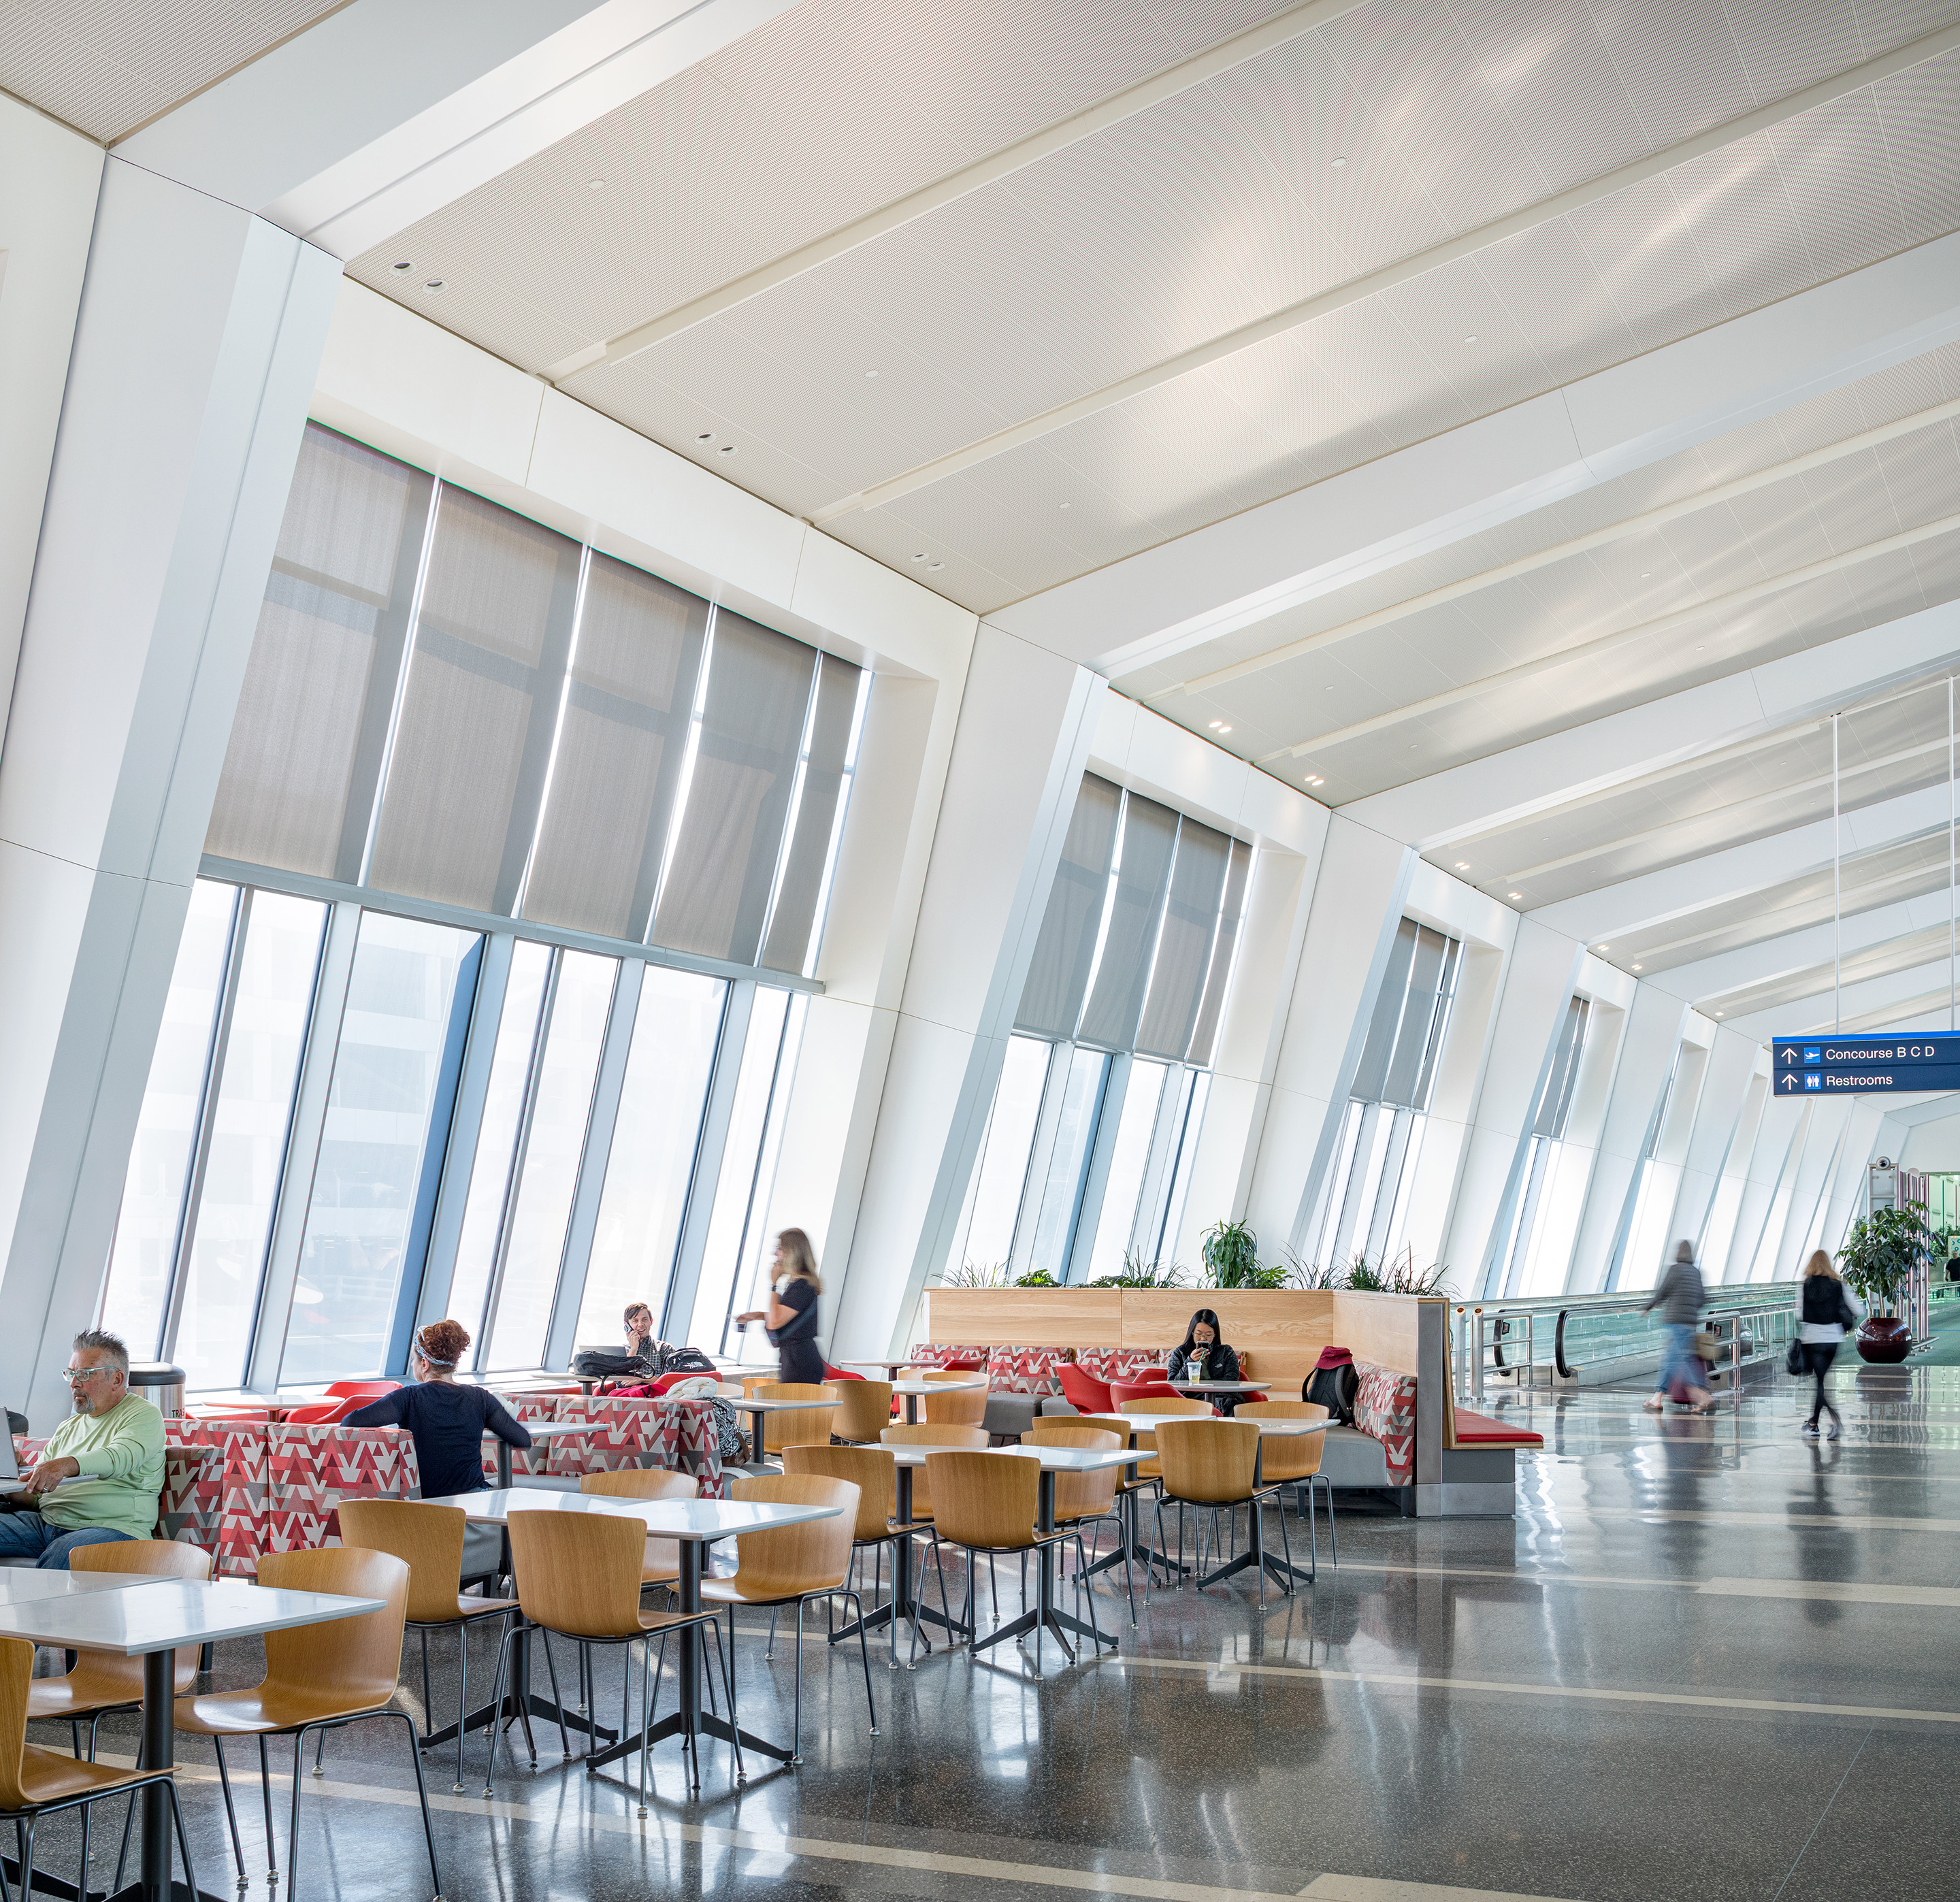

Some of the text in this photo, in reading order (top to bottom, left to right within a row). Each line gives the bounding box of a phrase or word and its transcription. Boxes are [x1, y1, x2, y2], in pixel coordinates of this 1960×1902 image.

[1825, 1045, 1935, 1060] Concourse B C D
[1826, 1075, 1893, 1086] Restrooms
